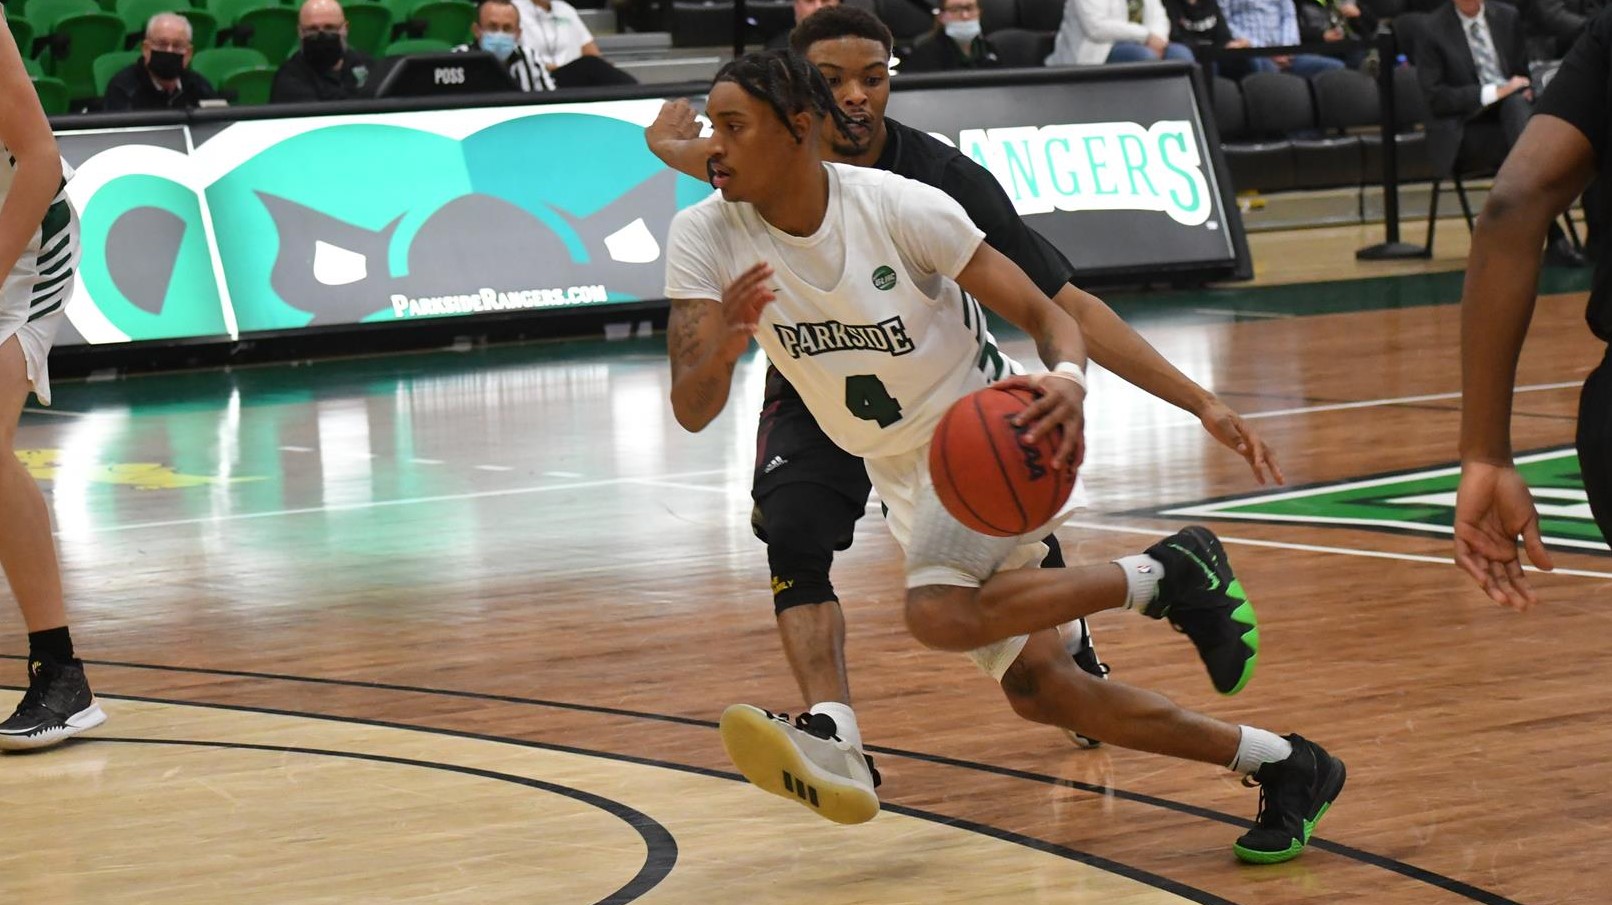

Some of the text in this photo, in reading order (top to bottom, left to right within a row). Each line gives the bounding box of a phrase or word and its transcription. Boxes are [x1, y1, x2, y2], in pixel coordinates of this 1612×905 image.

[434, 67, 465, 84] POSS
[969, 130, 1202, 213] NGERS
[773, 315, 915, 359] PARKSIDE
[845, 374, 903, 429] 4
